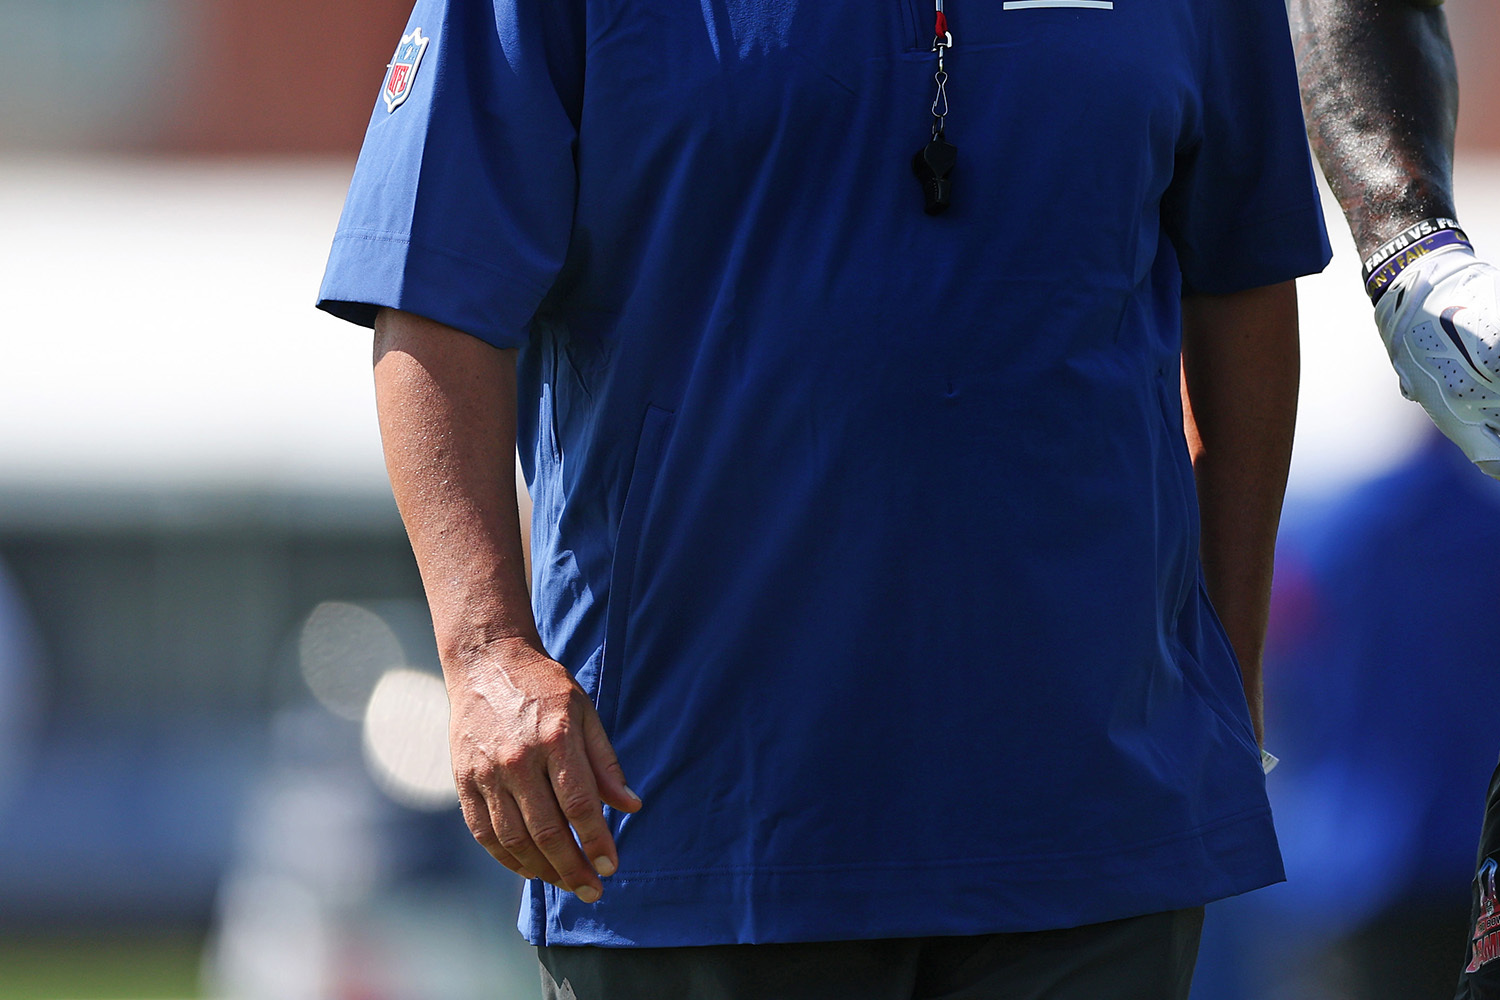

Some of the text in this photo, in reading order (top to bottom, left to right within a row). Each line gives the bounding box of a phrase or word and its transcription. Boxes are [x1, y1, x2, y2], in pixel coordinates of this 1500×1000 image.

[1365, 237, 1409, 273] FAITH
[1407, 220, 1438, 240] VS.
[1367, 243, 1431, 299] AN'T FAIL
